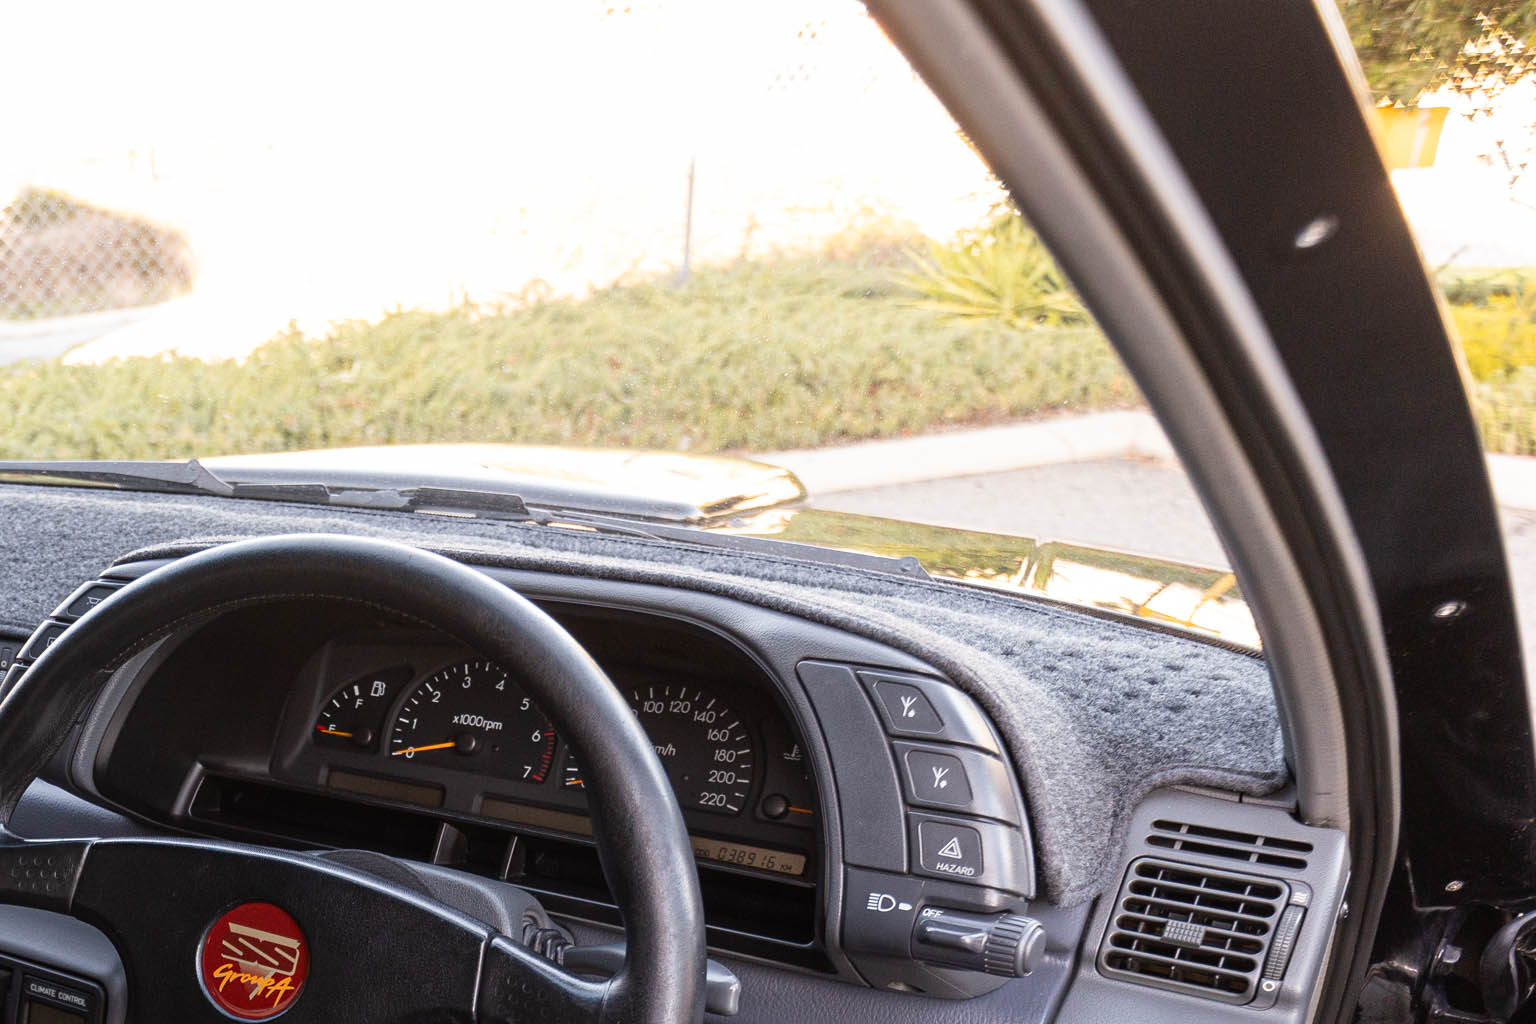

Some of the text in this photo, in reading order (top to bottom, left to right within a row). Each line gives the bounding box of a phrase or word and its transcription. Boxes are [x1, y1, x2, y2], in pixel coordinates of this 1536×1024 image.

[462, 677, 472, 688] 3
[495, 680, 505, 691] 4
[354, 698, 364, 709] F
[431, 691, 441, 703] 2
[520, 698, 530, 710] 5
[643, 700, 664, 714] 100
[669, 700, 691, 714] 120
[693, 710, 716, 724] 140
[411, 718, 418, 730] 1
[531, 729, 542, 743] 6
[707, 729, 730, 742] 160
[714, 749, 736, 764] 180
[522, 766, 533, 779] 7
[708, 770, 736, 785] 200
[699, 791, 727, 807] 220
[936, 862, 975, 876] HAZARD
[922, 907, 943, 918] OFF
[30, 983, 86, 1007] CLIMATE CONTROL
